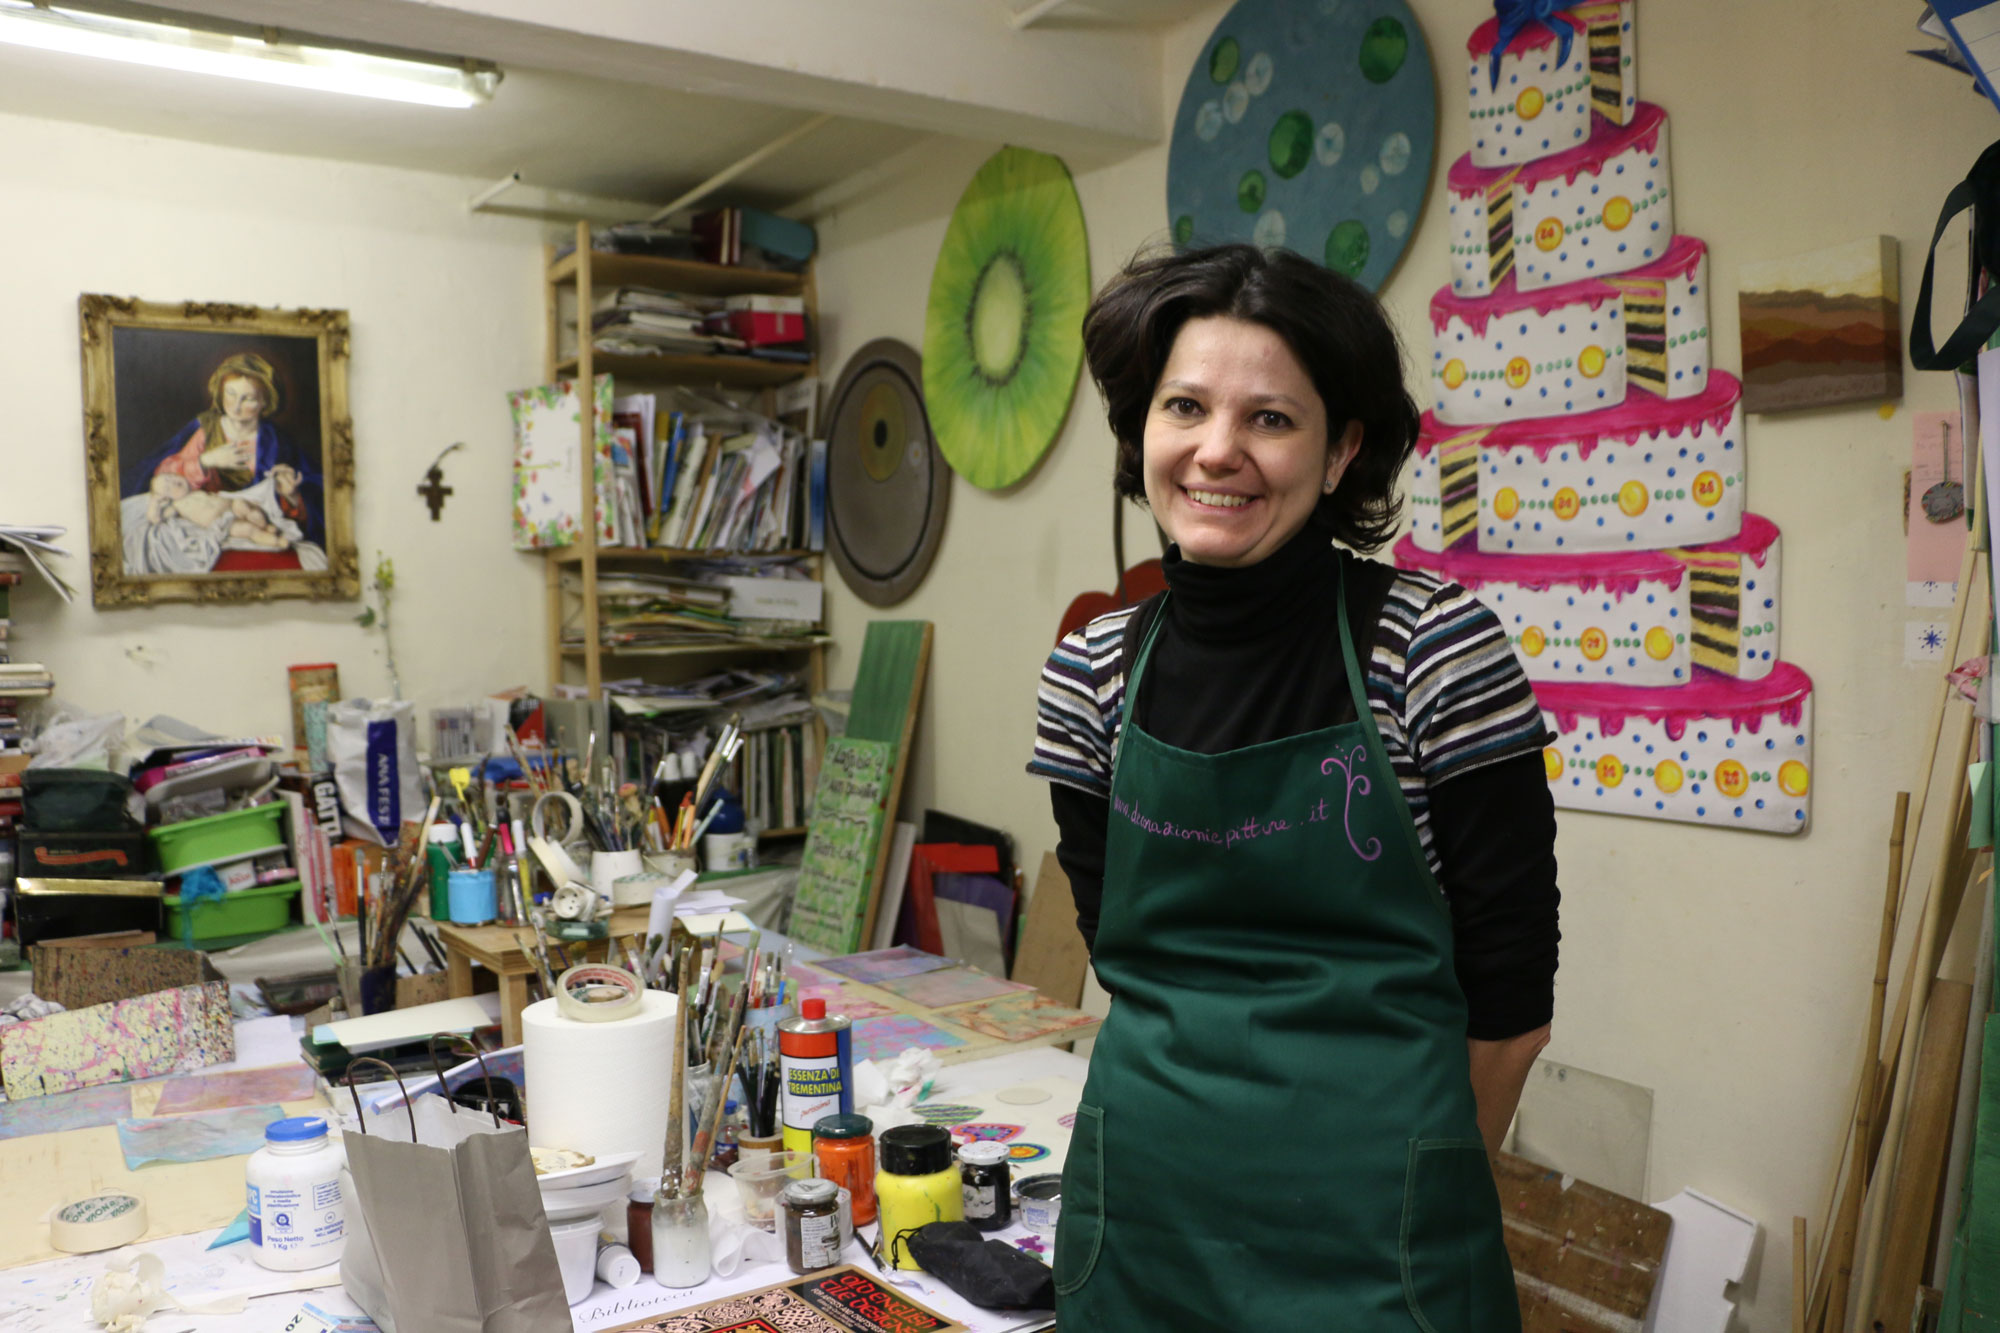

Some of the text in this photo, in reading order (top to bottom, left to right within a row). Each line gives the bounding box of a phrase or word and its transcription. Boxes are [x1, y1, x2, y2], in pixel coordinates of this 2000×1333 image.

[788, 1067, 840, 1081] ESSENZA DI
[787, 1080, 842, 1095] TREMENTINA
[840, 1275, 875, 1294] OLD
[579, 1290, 694, 1323] Biblioteca
